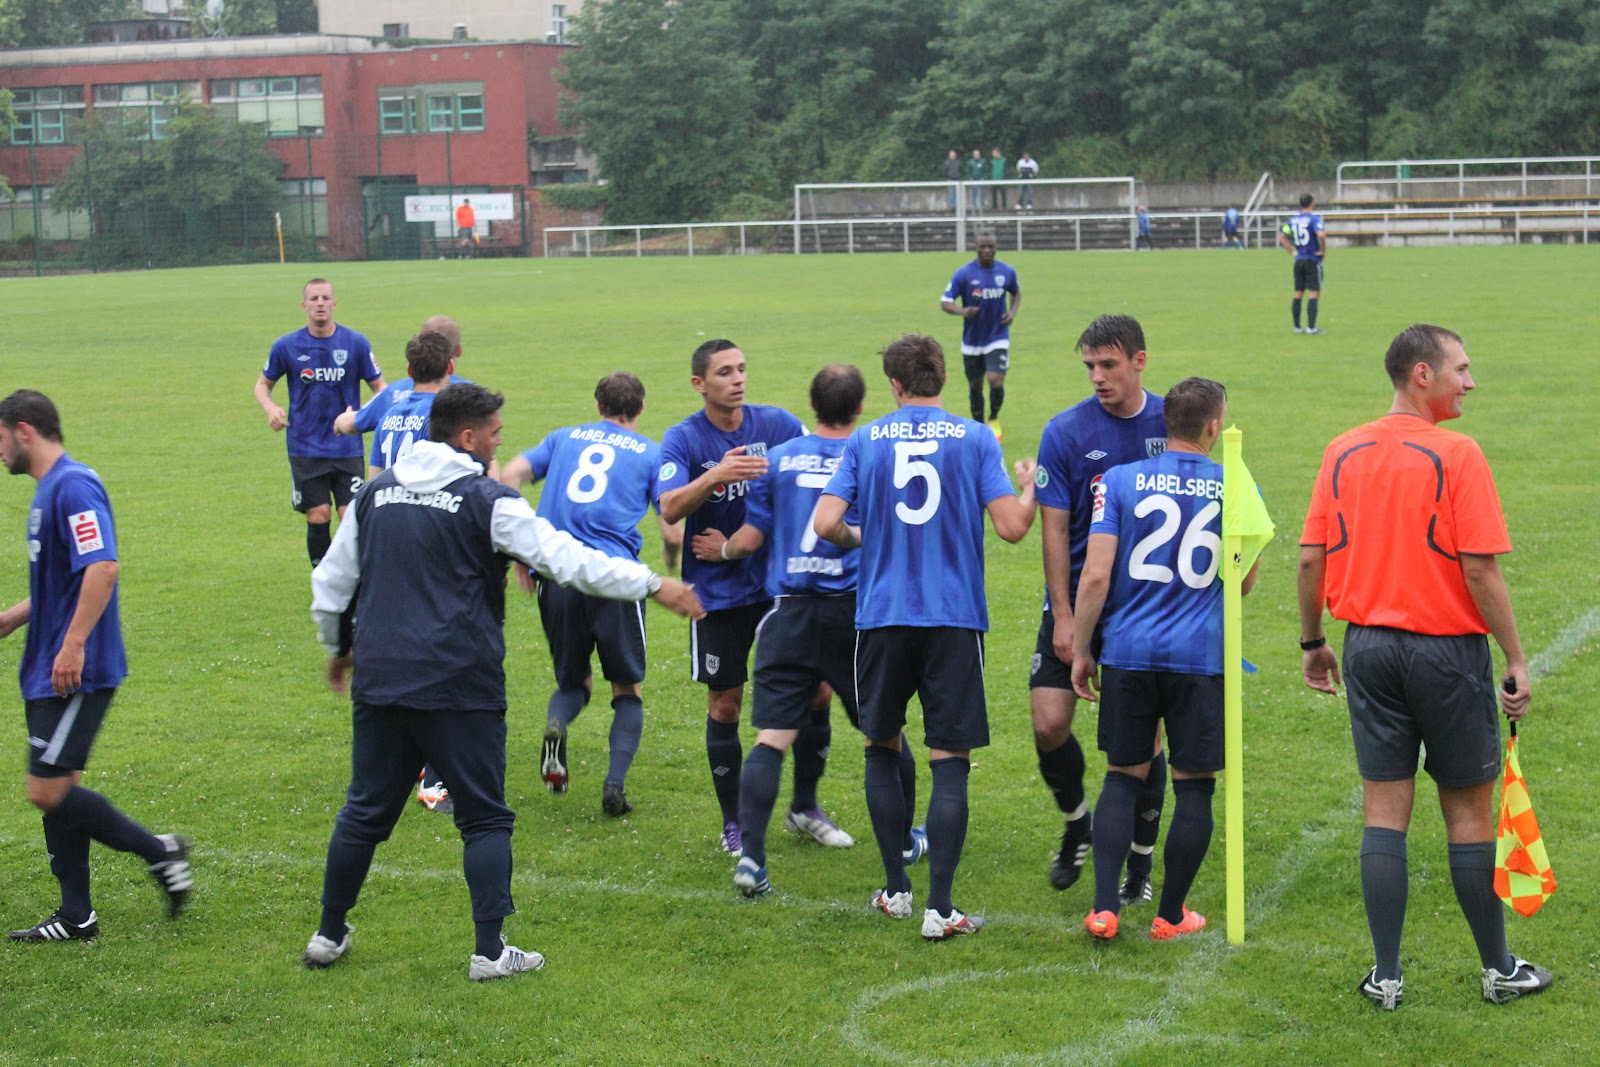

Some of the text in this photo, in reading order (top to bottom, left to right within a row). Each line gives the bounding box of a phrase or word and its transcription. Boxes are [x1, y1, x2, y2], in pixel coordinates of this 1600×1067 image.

[1291, 222, 1310, 246] 15
[983, 287, 1005, 299] EWP
[315, 367, 345, 382] EWP
[381, 415, 425, 431] BABELSBERG
[871, 421, 966, 440] BABELSBERG
[569, 428, 647, 454] BABELSBERG
[566, 443, 615, 504] 8
[893, 440, 941, 525] 5
[374, 486, 463, 513] BABELSBERG
[1135, 473, 1224, 501] BABELSBER
[796, 473, 833, 553] 7
[1128, 494, 1222, 589] 26
